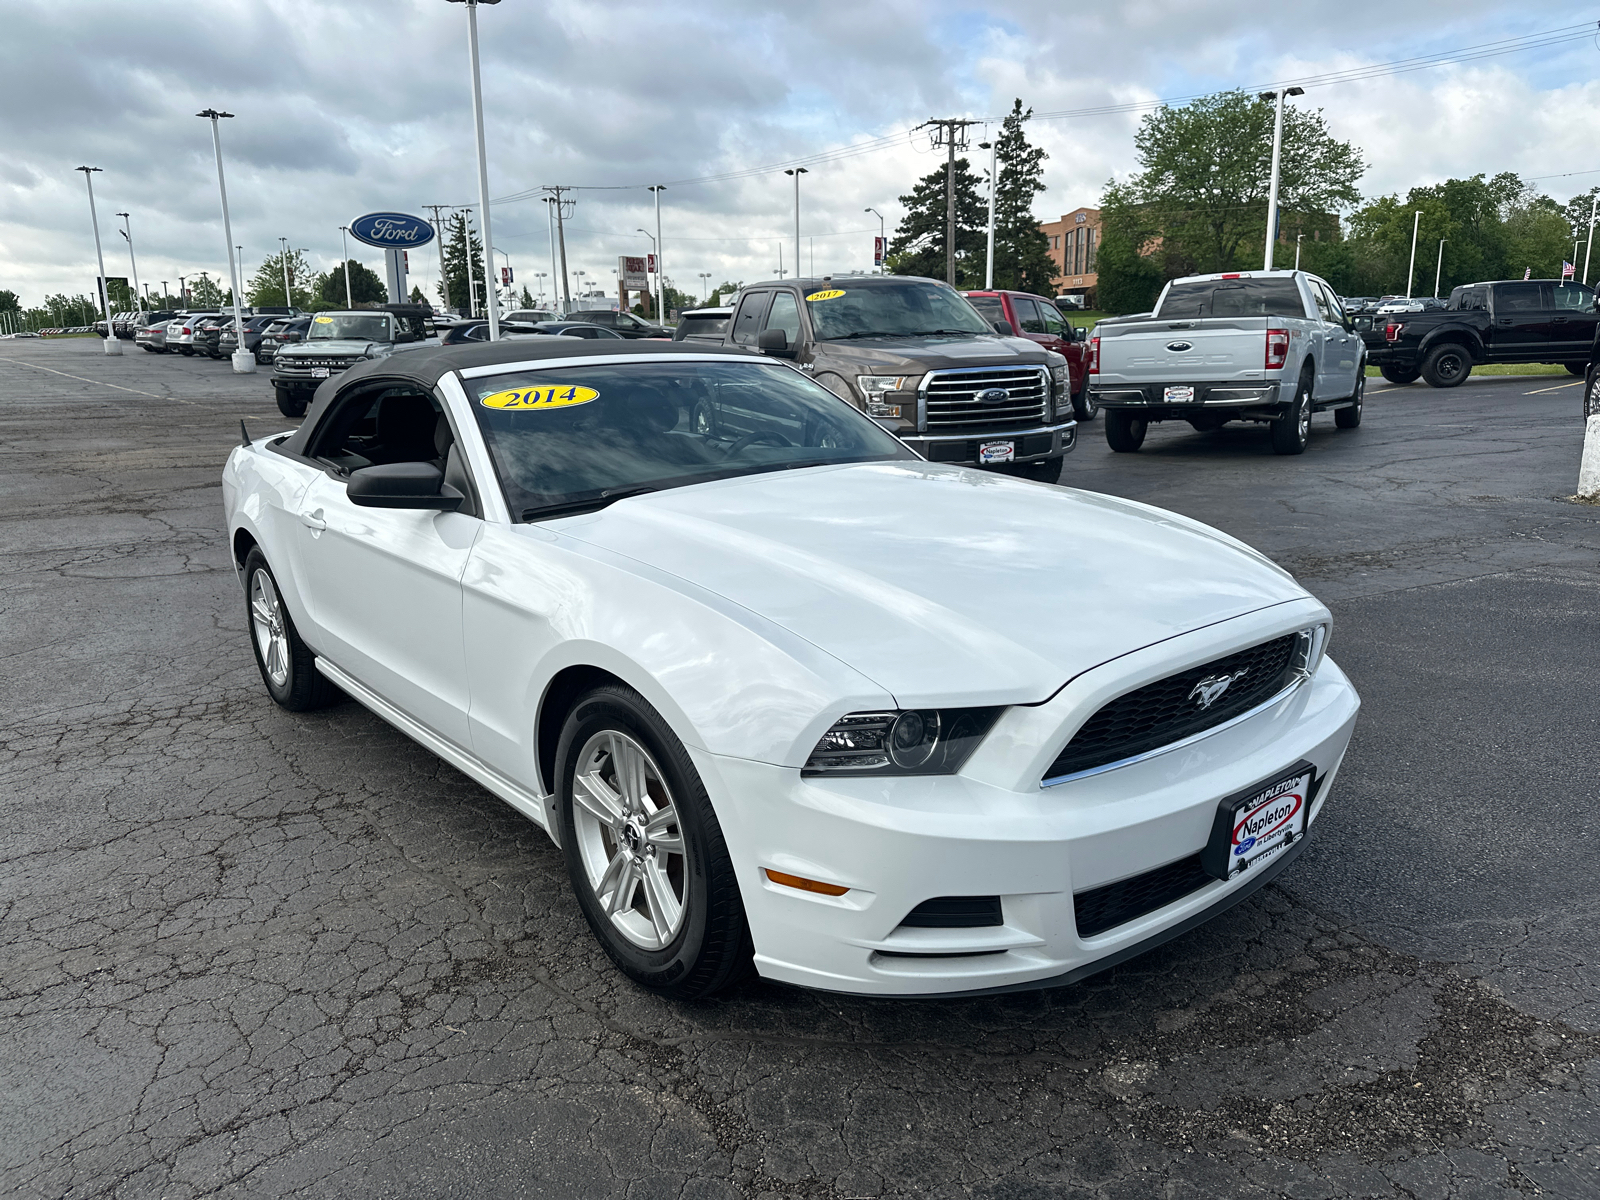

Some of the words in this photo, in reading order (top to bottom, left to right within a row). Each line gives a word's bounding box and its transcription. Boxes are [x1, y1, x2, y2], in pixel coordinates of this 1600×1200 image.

[370, 219, 419, 241] Ford
[814, 290, 839, 301] 2017
[1128, 354, 1234, 368] F-150
[503, 386, 577, 408] 2014
[985, 447, 1008, 455] Napleton
[1242, 803, 1291, 839] Napleton
[1263, 823, 1294, 844] Libertyville
[1237, 839, 1254, 854] Ford
